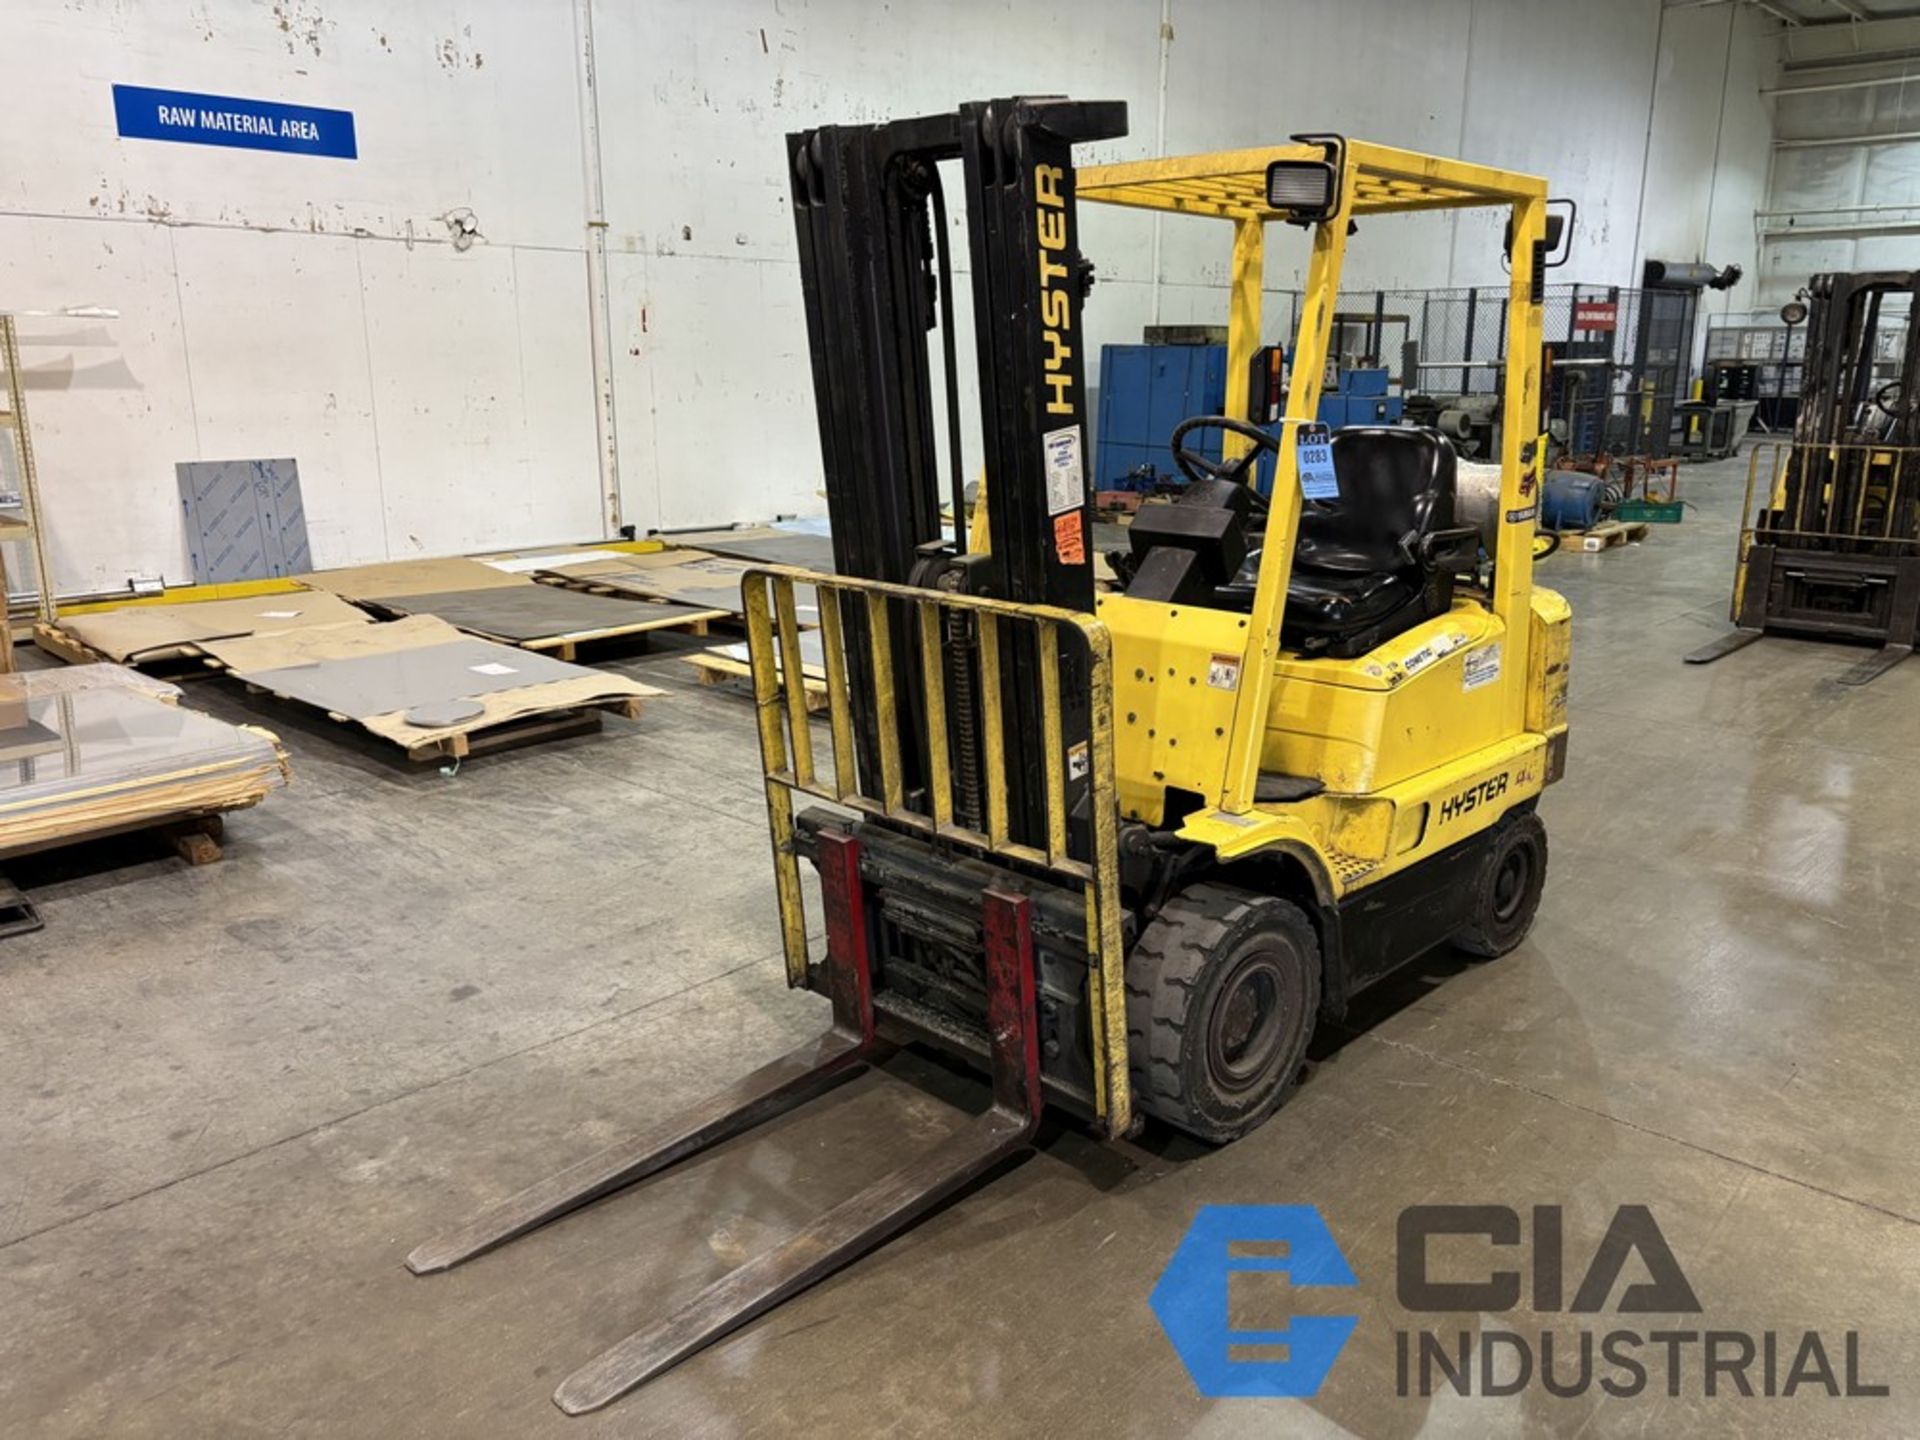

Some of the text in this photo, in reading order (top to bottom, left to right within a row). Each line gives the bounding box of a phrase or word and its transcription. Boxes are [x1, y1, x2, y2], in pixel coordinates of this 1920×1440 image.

[158, 105, 320, 141] RAW MATERIAL AREA
[1034, 163, 1074, 415] HYSTER
[1299, 433, 1327, 445] LOT
[1439, 771, 1509, 826] HYSTER
